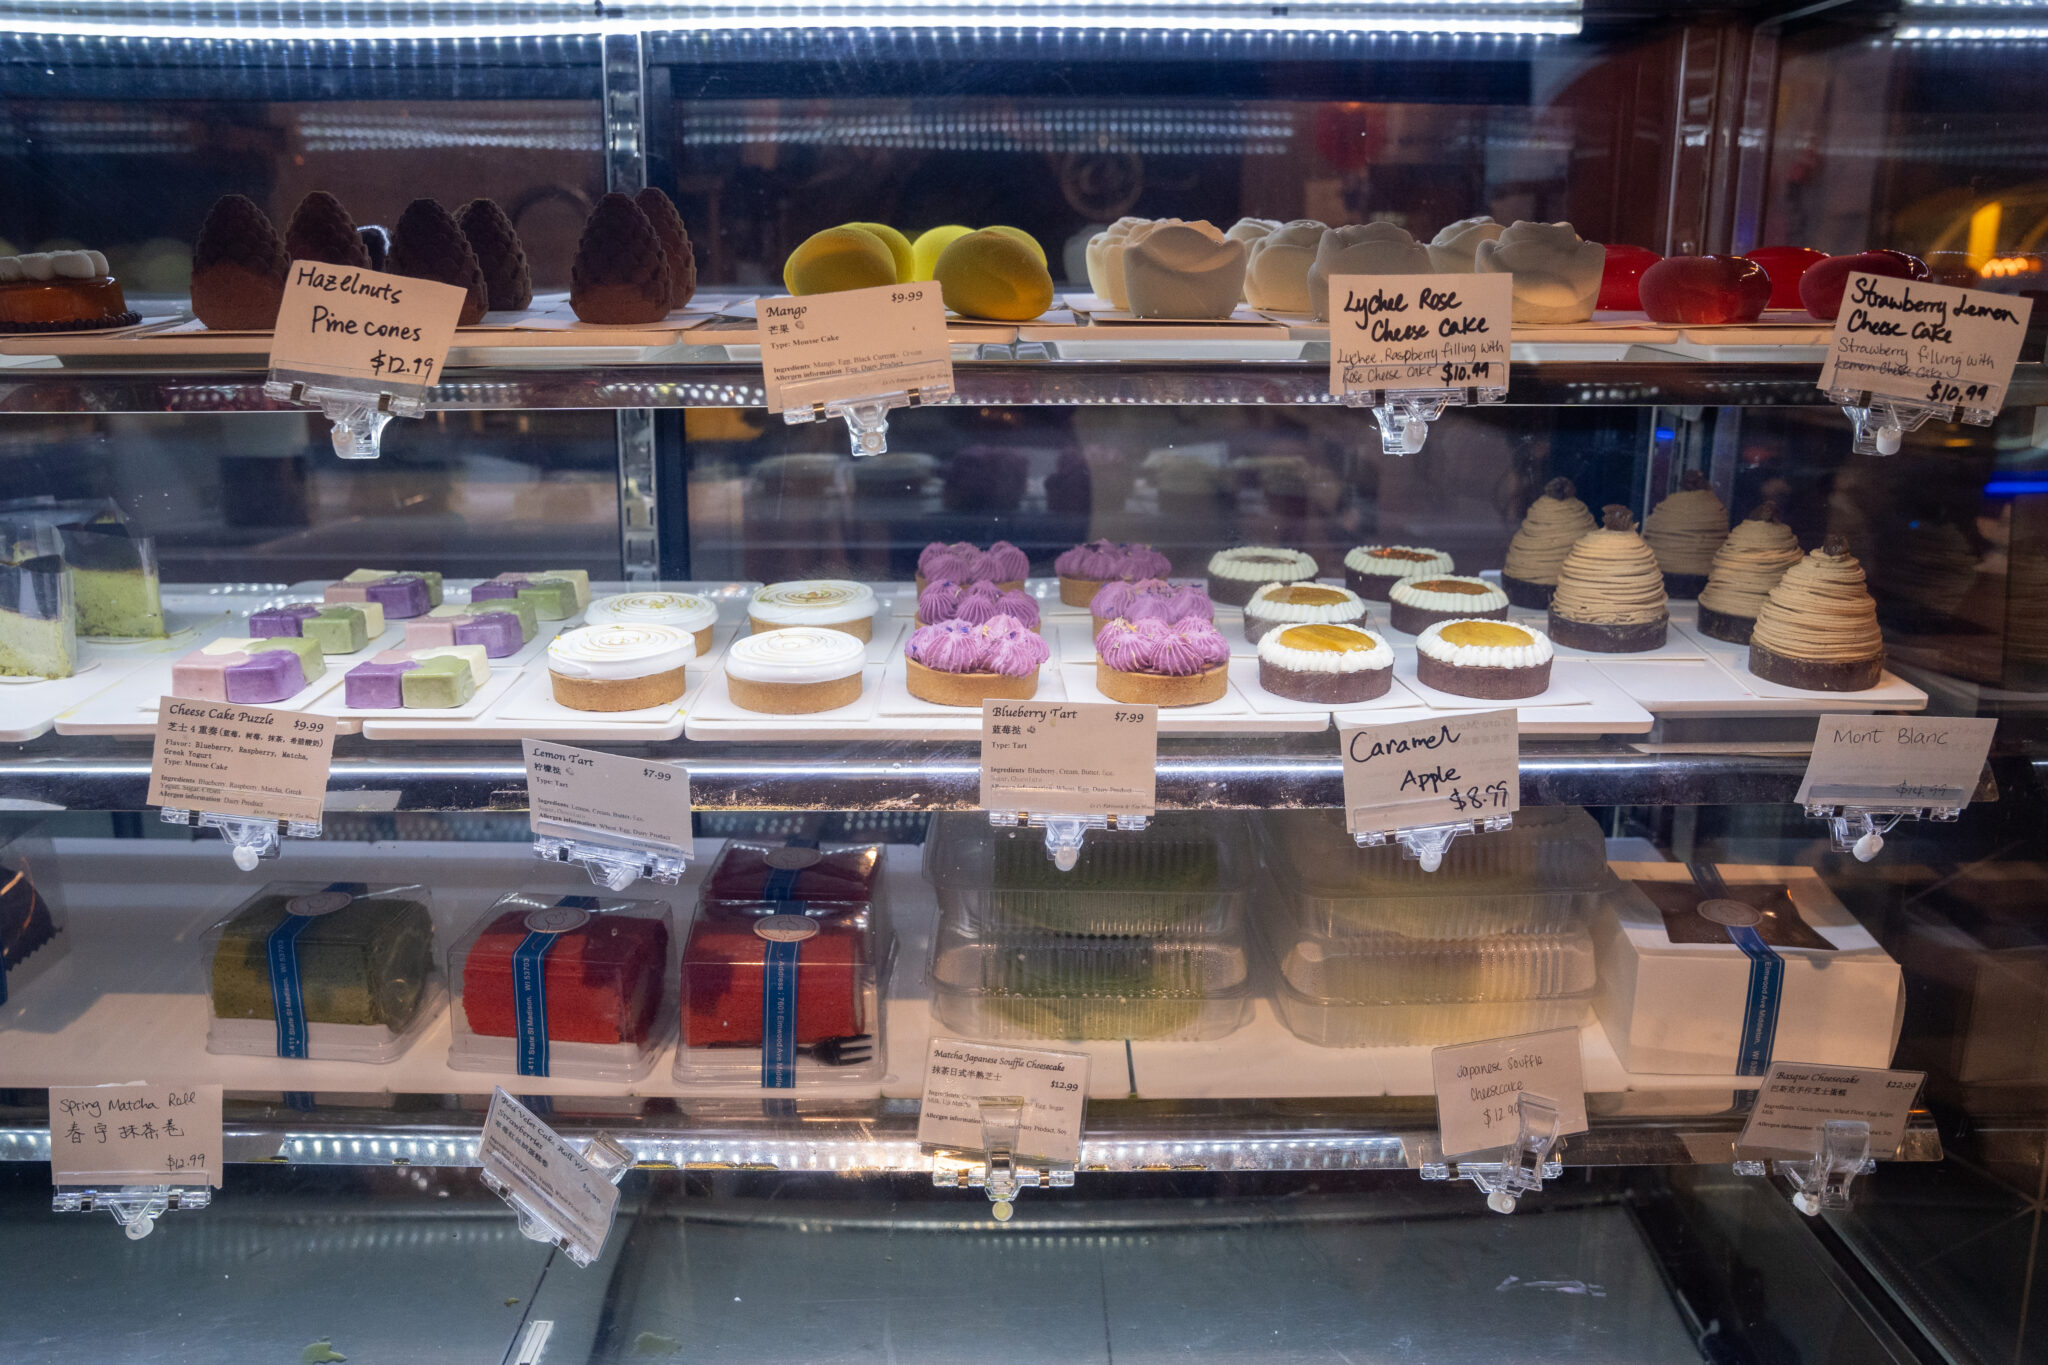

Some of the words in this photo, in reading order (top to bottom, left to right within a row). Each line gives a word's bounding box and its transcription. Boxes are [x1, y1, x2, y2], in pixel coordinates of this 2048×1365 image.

[297, 267, 403, 304] Hazelnuts
[766, 305, 807, 319] Mango
[891, 291, 923, 303] $9.99
[1344, 289, 1408, 329] Lychee
[1419, 288, 1462, 310] Rose
[1851, 277, 1946, 326] Strawberry
[1953, 294, 2019, 325] Lemon
[312, 305, 357, 333] Pine
[364, 321, 421, 341] cones
[768, 324, 790, 335] 芒果
[1371, 318, 1429, 342] Cheese
[1847, 309, 1907, 336] Cheese
[1911, 321, 1952, 343] Cake
[771, 341, 791, 350] Type:
[792, 337, 819, 347] Mousse
[821, 335, 840, 343] Cake
[370, 349, 433, 379] $12.99
[1385, 348, 1437, 368] Raspberry
[1441, 342, 1476, 363] filling
[1480, 341, 1504, 354] with
[1838, 337, 1908, 367] Strawberry
[1918, 346, 1962, 378] filling
[1967, 356, 1994, 369] with
[1342, 368, 1362, 384] Rose
[1367, 368, 1401, 384] Cheese
[1441, 361, 1489, 387] $10.99
[169, 704, 205, 717] Cheese
[208, 708, 235, 721] Cake
[238, 712, 274, 725] Puzzle
[293, 719, 324, 733] $9.99
[992, 705, 1047, 723] Blueberry
[1050, 707, 1078, 719] Tart
[1114, 712, 1144, 723] $7.99
[992, 742, 1011, 750] Type:
[1350, 725, 1461, 763] Caramel
[1833, 728, 1885, 744] Mont
[1897, 727, 1949, 745] Blanc
[164, 748, 185, 757] Greek
[188, 750, 212, 760] Yogurt
[165, 739, 192, 747] Flavor:
[196, 741, 234, 753] Blueberry,
[239, 746, 277, 758] Raspberry,
[282, 751, 309, 761] Matcha,
[164, 758, 183, 766] Type:
[185, 759, 209, 769] Mousse
[210, 762, 228, 771] Cake
[532, 748, 566, 761] Lemon
[569, 754, 594, 767] Tart
[643, 768, 672, 781] $7.99
[1400, 766, 1461, 793] Apple
[1450, 781, 1507, 812] $8.99
[523, 958, 531, 980] 53703
[777, 961, 785, 990] Address
[1761, 961, 1772, 995] Elmwood
[525, 981, 532, 991] WI
[1759, 995, 1768, 1009] Ave
[776, 1015, 784, 1047] Elmwood
[288, 1037, 296, 1051] 411
[775, 1047, 783, 1061] Ave
[1752, 1050, 1760, 1060] WI
[934, 1050, 963, 1061] Matcha
[964, 1053, 997, 1064] Japanese
[1026, 1060, 1065, 1072] Cheesecake
[1457, 1062, 1502, 1079] Japanese
[1050, 1080, 1078, 1092] $12.99
[1776, 1071, 1809, 1084] Basque
[1811, 1073, 1860, 1084] Cheesecake
[1470, 1080, 1523, 1101] Cheesecake
[59, 1099, 101, 1118] Spring
[108, 1098, 160, 1111] Matcha
[168, 1091, 196, 1107] Roll
[498, 1109, 543, 1150] Strawberries
[166, 1153, 206, 1171] $12.99
[557, 1145, 573, 1162] Roll
